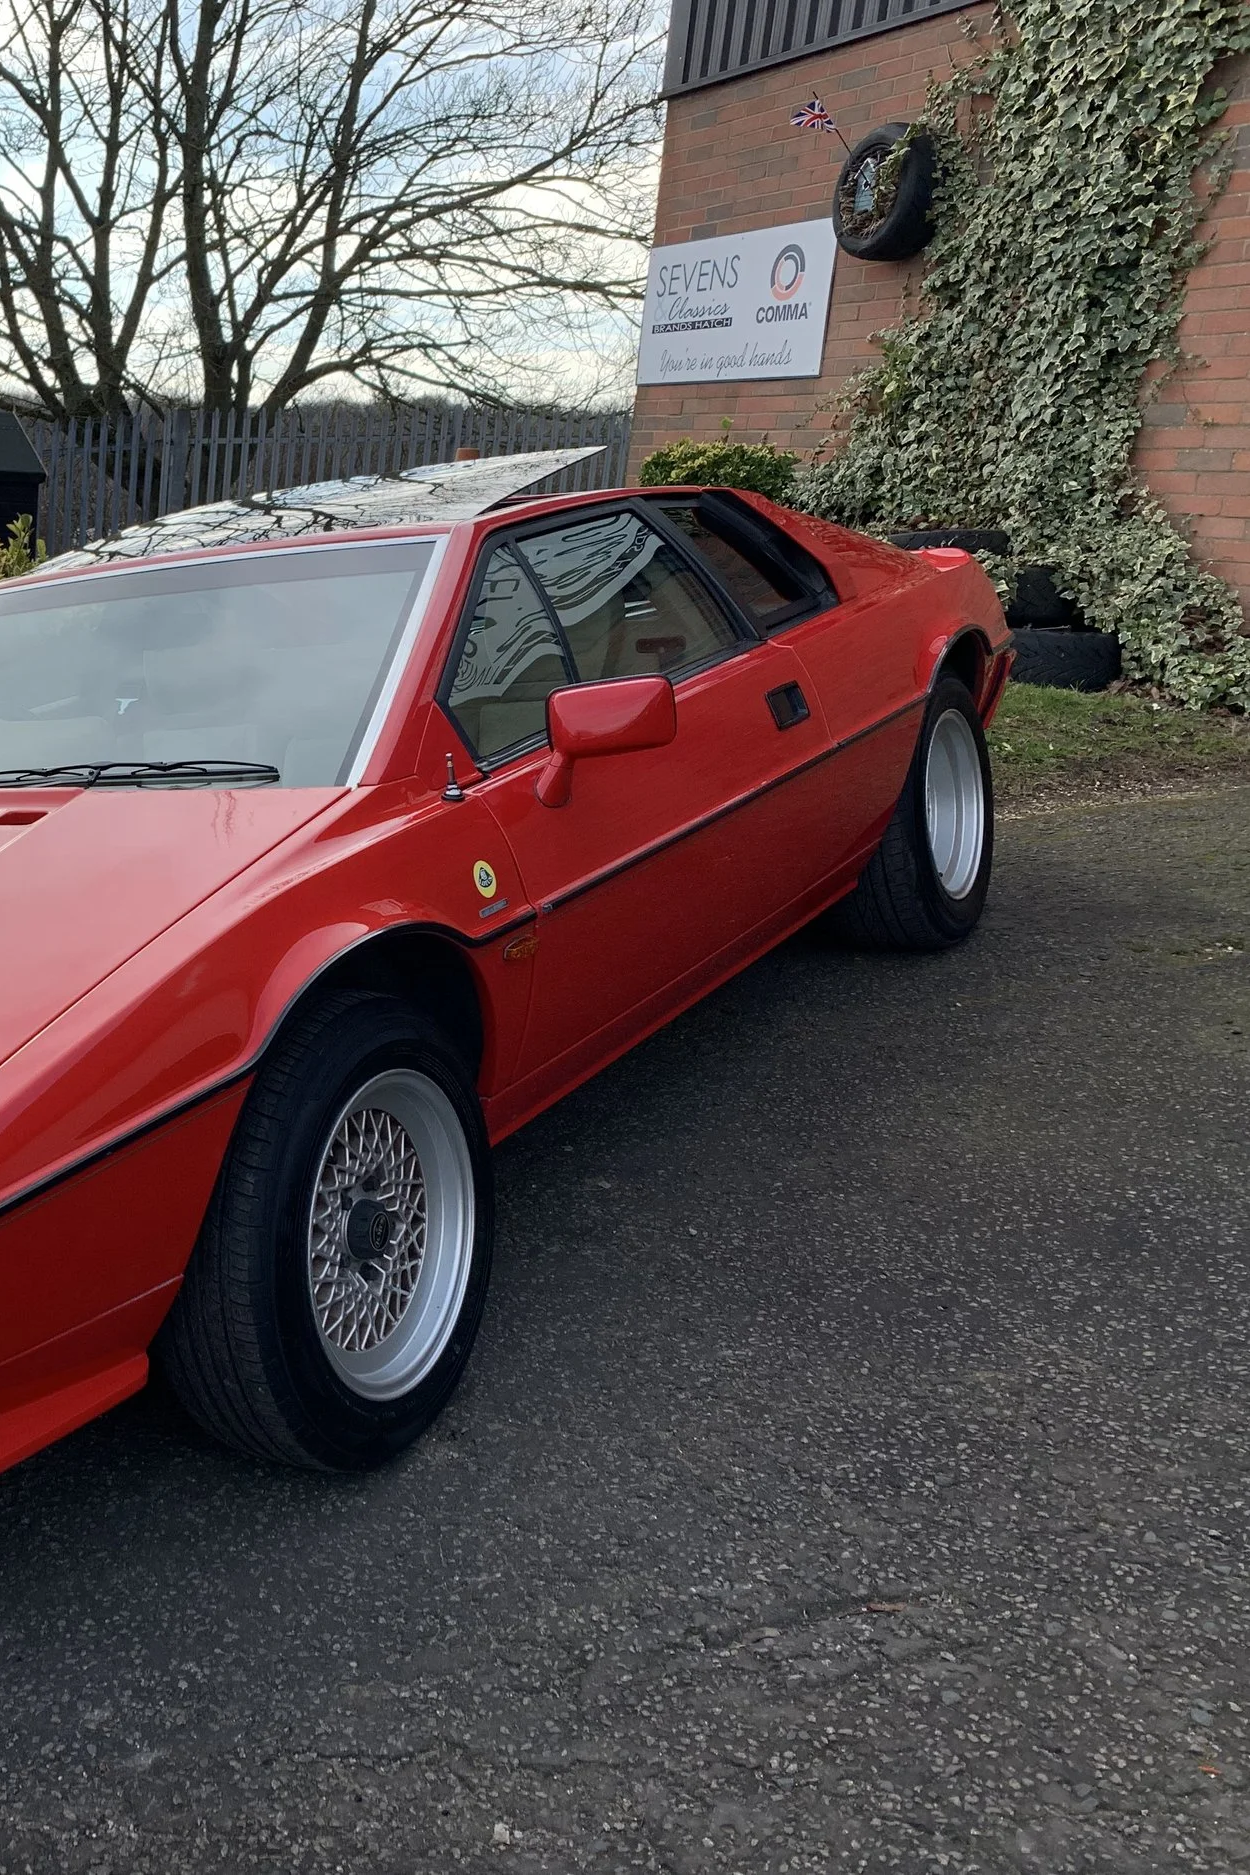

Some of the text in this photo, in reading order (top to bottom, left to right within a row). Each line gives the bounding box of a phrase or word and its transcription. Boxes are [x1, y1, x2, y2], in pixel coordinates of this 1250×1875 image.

[656, 254, 741, 298] SEVENS
[668, 297, 731, 322] Classics
[653, 318, 732, 334] BRANDS HATCH
[700, 352, 714, 371] in
[716, 342, 749, 378] good
[748, 339, 793, 367] hands
